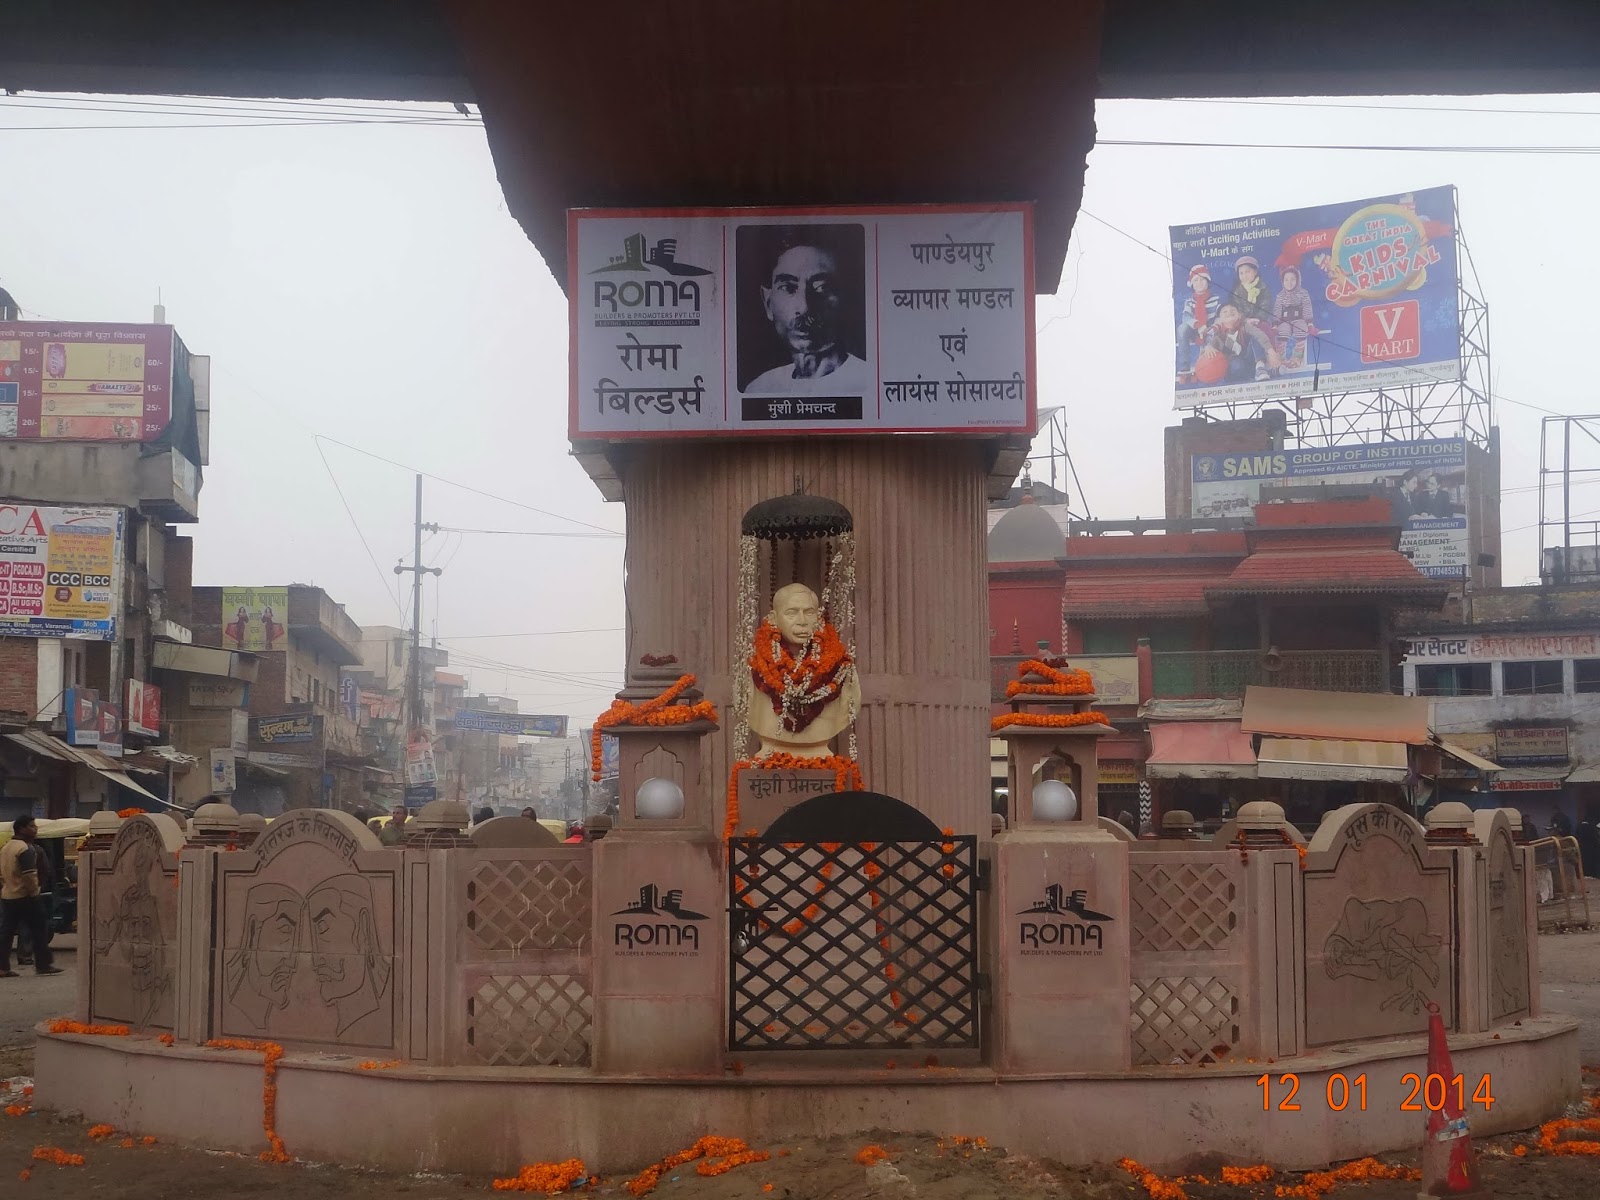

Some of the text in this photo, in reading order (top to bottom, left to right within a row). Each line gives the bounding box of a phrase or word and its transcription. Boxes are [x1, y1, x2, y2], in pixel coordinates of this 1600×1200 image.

[1209, 217, 1249, 233] Unlimited
[1250, 217, 1266, 227] Fun
[1365, 218, 1387, 231] THE
[1207, 234, 1240, 245] Exciting
[1242, 228, 1280, 241] Activities
[1296, 232, 1327, 247] V-Mart
[1343, 224, 1413, 247] GREAT INDIA
[910, 233, 996, 272] पाण्डेयपुर
[1200, 247, 1230, 259] V-Mart
[1349, 237, 1408, 275] KIDS
[1326, 245, 1442, 302] CARNIVAL
[594, 280, 701, 313] ROMA
[891, 287, 1015, 311] व्यापार मण्डल
[1375, 307, 1405, 340] V
[616, 332, 683, 372] रोमा
[938, 327, 968, 363] एवं
[1366, 338, 1416, 358] MART
[23, 367, 39, 375] 15/-
[146, 384, 162, 392] 15/-
[593, 374, 706, 415] बिल्डर्स
[883, 370, 1025, 403] लायंस सोसायटी
[1207, 389, 1223, 397] PDR
[145, 404, 162, 412] 25/-
[768, 400, 836, 419] मुंशी प्रेमचन्द
[22, 419, 38, 427] 20/-
[145, 424, 161, 432] 25/-
[1223, 442, 1462, 478] SAMS GROUP OF INSTITUTIONS
[1293, 465, 1325, 475] Approved
[1336, 463, 1359, 471] AICTE,
[1360, 461, 1387, 470] Ministry
[1396, 459, 1414, 467] HRD,
[1442, 456, 1463, 464] INDIA
[1412, 521, 1460, 530] MANAGEMENT
[1400, 532, 1418, 540] egree
[1423, 531, 1449, 539] Diploma
[1, 545, 34, 553] Certified
[49, 573, 81, 585] CCC
[84, 575, 110, 587] BCC
[12, 607, 35, 615] Course
[748, 773, 784, 799] मुंशी
[296, 811, 312, 833] के
[1344, 804, 1415, 847] पूस की रात
[615, 923, 699, 950] ROMA
[1020, 923, 1103, 949] ROMA
